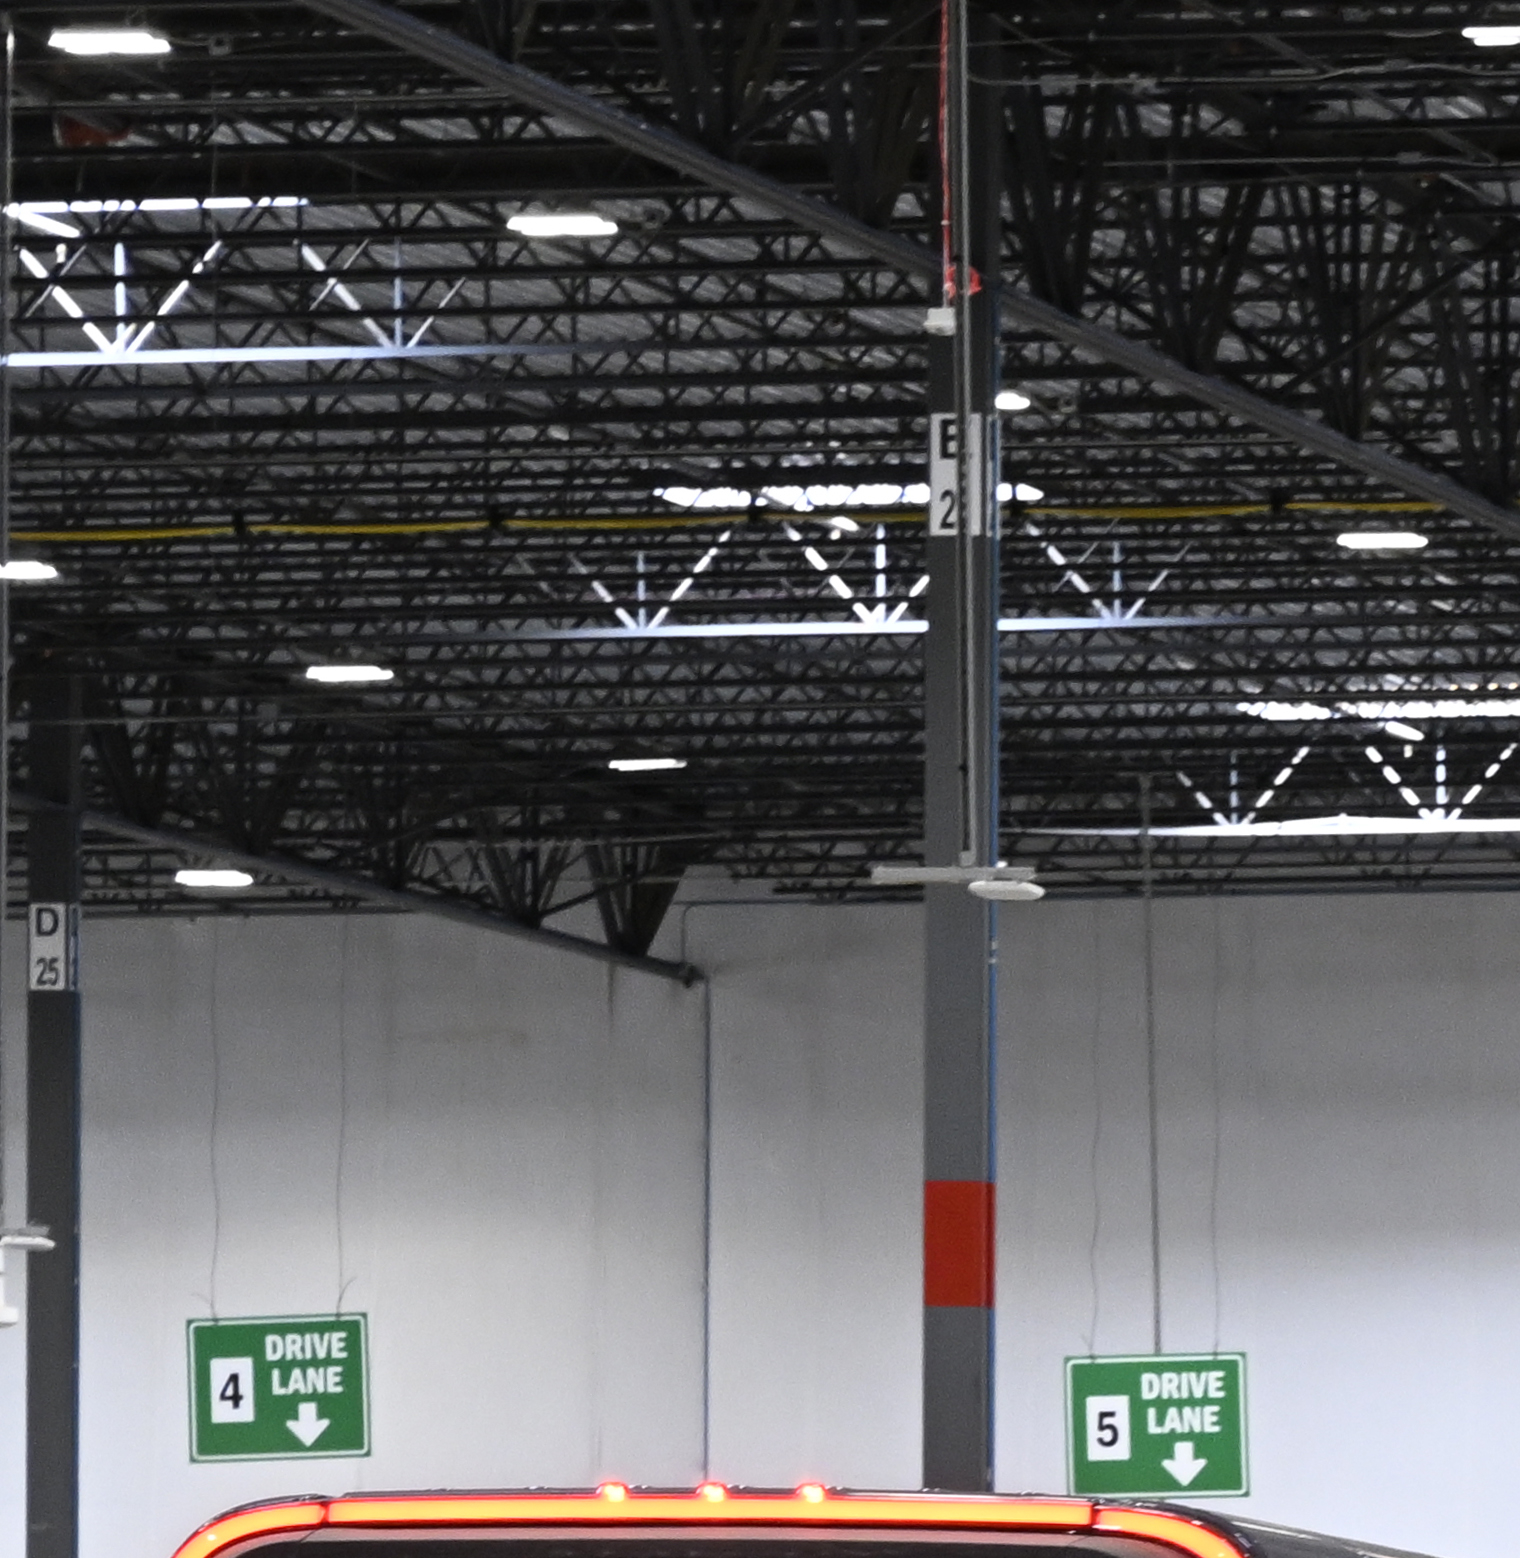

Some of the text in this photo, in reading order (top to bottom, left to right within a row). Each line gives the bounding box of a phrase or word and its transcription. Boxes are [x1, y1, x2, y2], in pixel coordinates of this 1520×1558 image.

[36, 907, 59, 937] D
[36, 957, 59, 986] 25
[265, 1331, 349, 1362] DRIVE
[219, 1372, 244, 1410] 4
[271, 1366, 344, 1395] LANE
[1141, 1370, 1226, 1400] DRIVE
[1096, 1411, 1119, 1448] 5
[1147, 1405, 1222, 1434] LANE
